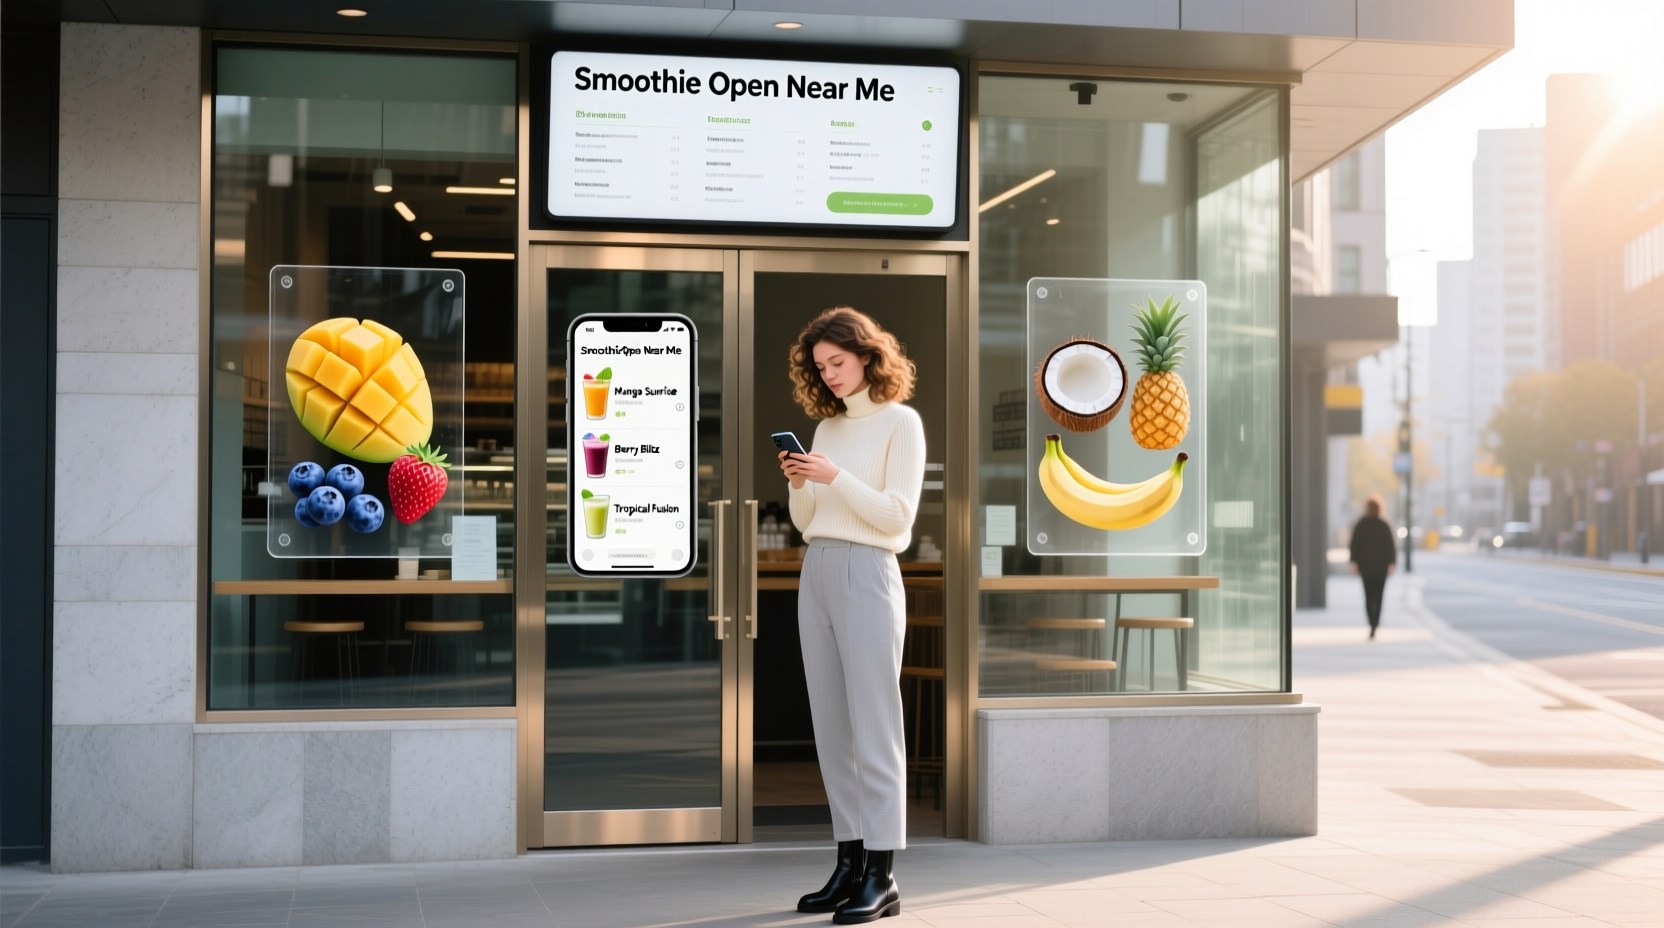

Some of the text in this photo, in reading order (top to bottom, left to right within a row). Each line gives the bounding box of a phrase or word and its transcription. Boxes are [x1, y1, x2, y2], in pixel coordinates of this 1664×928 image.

[574, 66, 895, 102] Smoothie Open Near Me
[666, 345, 682, 355] Me
[614, 444, 639, 457] Berry
[613, 503, 651, 517] Tropical
